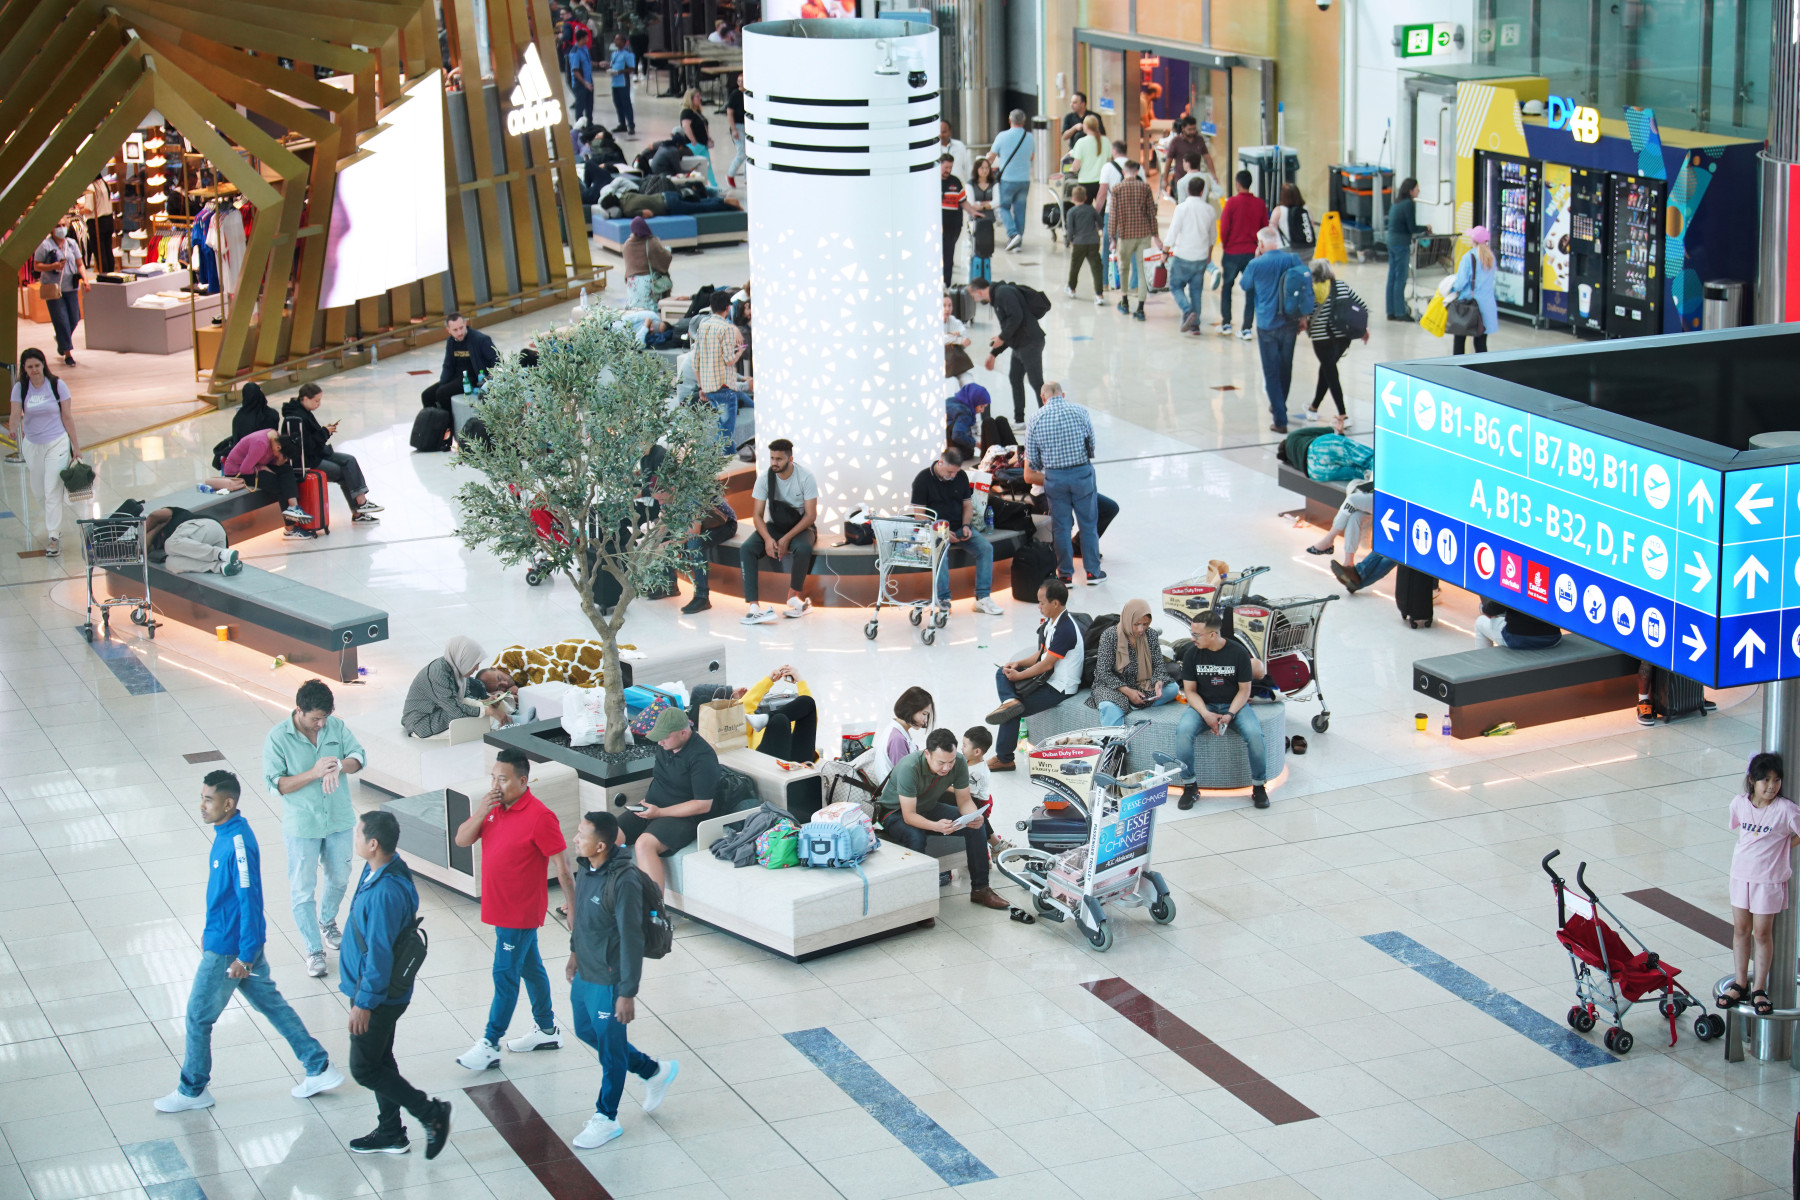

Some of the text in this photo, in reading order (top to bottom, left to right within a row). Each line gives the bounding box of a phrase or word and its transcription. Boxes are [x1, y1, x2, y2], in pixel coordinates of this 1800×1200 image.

[507, 99, 562, 136] adidas
[1548, 95, 1600, 143] DXB
[1528, 582, 1547, 596] Emirates
[1105, 827, 1149, 853] CHANGE
